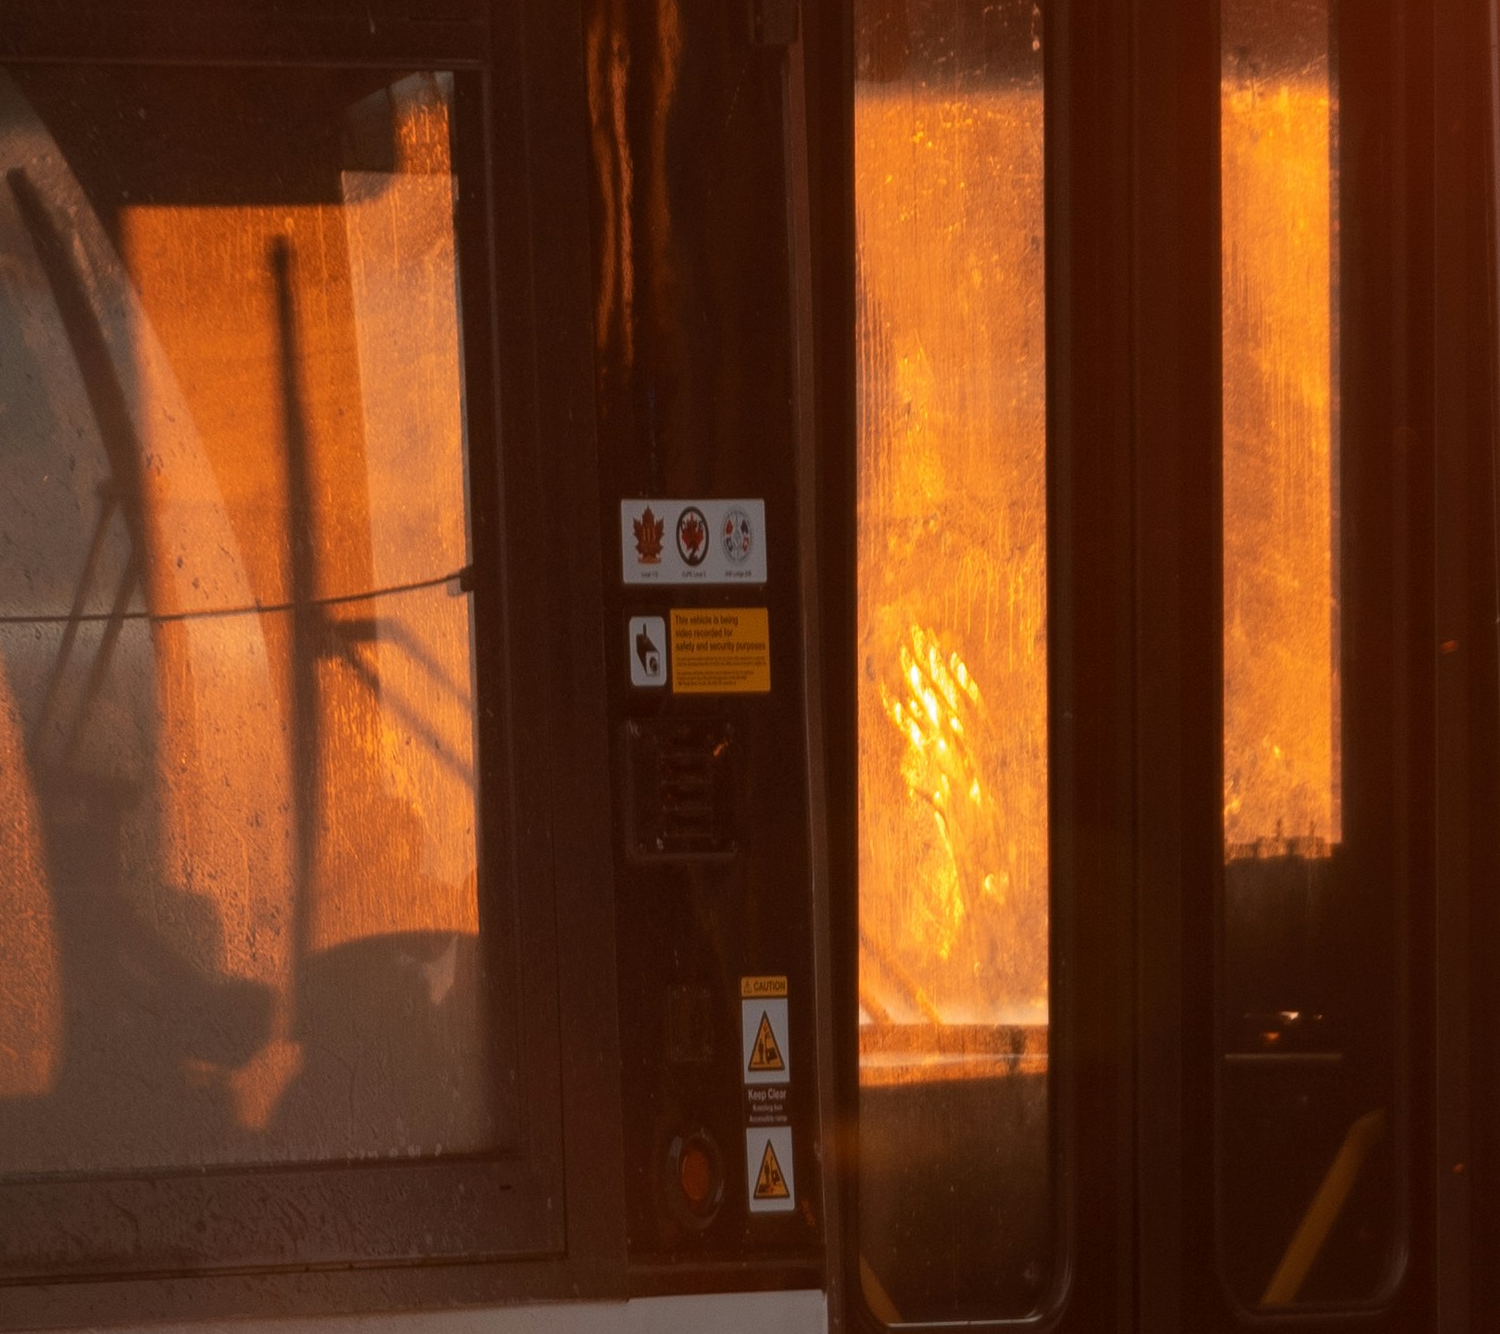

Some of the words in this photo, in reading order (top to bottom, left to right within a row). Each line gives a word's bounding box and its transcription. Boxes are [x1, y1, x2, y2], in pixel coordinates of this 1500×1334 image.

[753, 980, 786, 992] CAUTION
[747, 1088, 767, 1103] Keep
[767, 1087, 787, 1101] Clear
